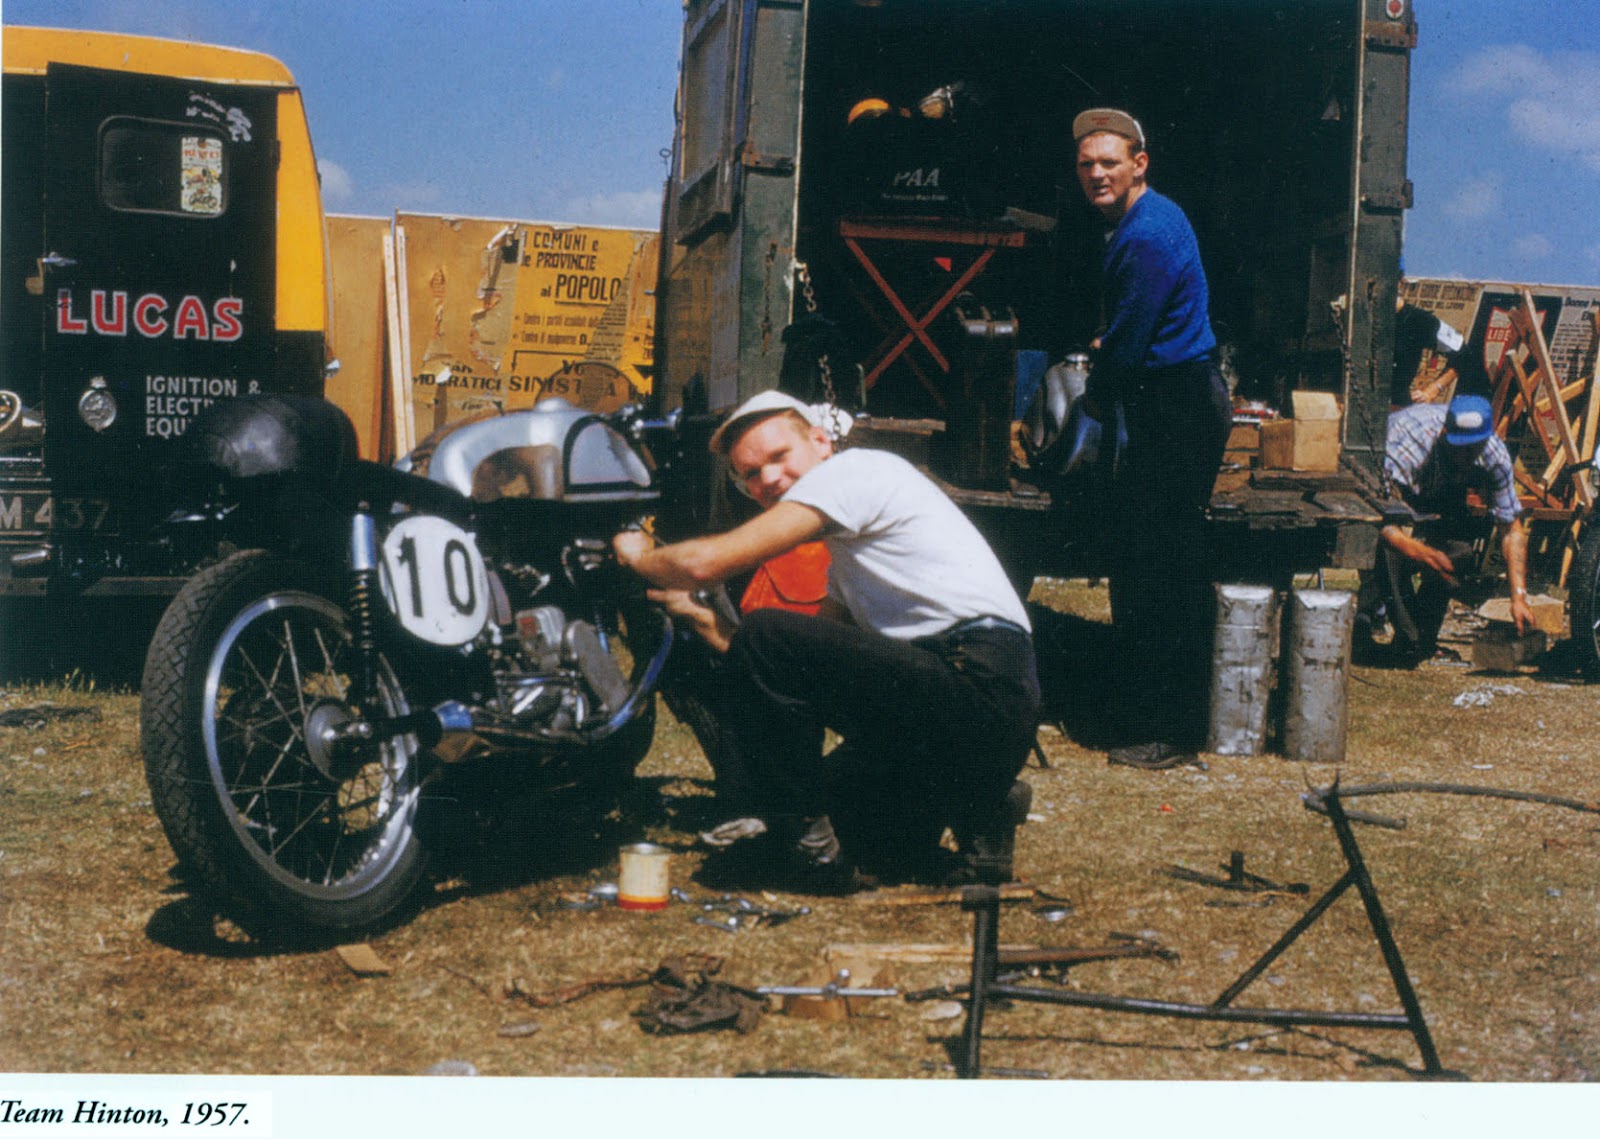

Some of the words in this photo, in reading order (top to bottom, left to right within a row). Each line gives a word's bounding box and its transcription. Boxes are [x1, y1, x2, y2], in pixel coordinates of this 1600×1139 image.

[533, 231, 587, 251] COMUNI
[536, 252, 598, 270] PROVINCIE
[541, 285, 552, 297] al
[555, 274, 622, 300] POPOLO
[57, 288, 243, 342] LUCAS
[146, 375, 237, 397] IGNITION
[248, 381, 261, 394] &
[146, 417, 192, 439] EQU
[397, 533, 477, 618] 10
